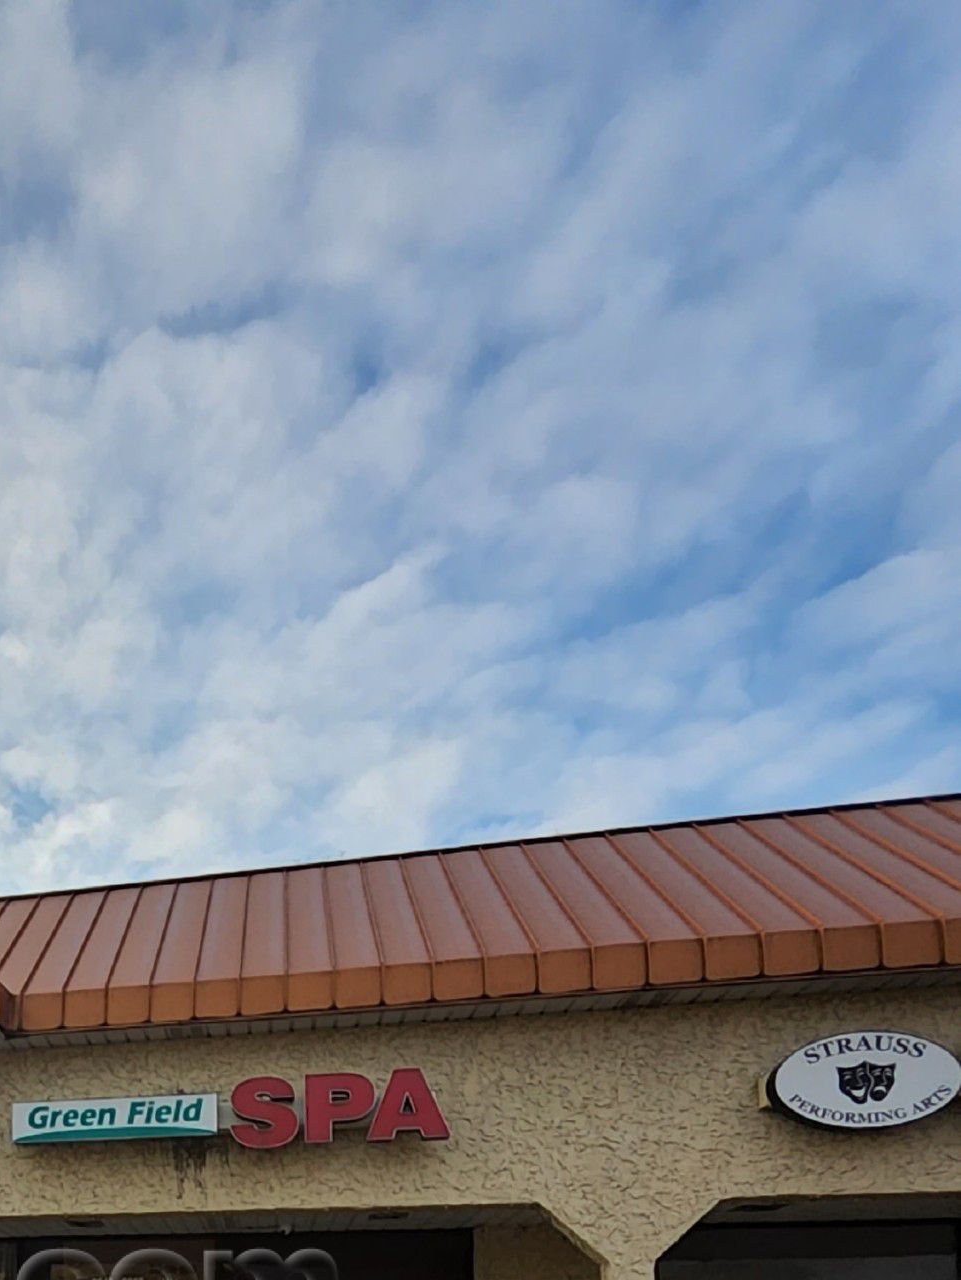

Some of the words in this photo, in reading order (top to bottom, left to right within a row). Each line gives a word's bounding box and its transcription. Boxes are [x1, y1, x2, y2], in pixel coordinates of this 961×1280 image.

[804, 1035, 927, 1064] STRAUSS
[28, 1105, 116, 1130] Green
[127, 1098, 203, 1126] Field
[230, 1067, 450, 1150] SPA
[789, 1094, 907, 1124] PERFORMING
[912, 1084, 953, 1115] ARTS
